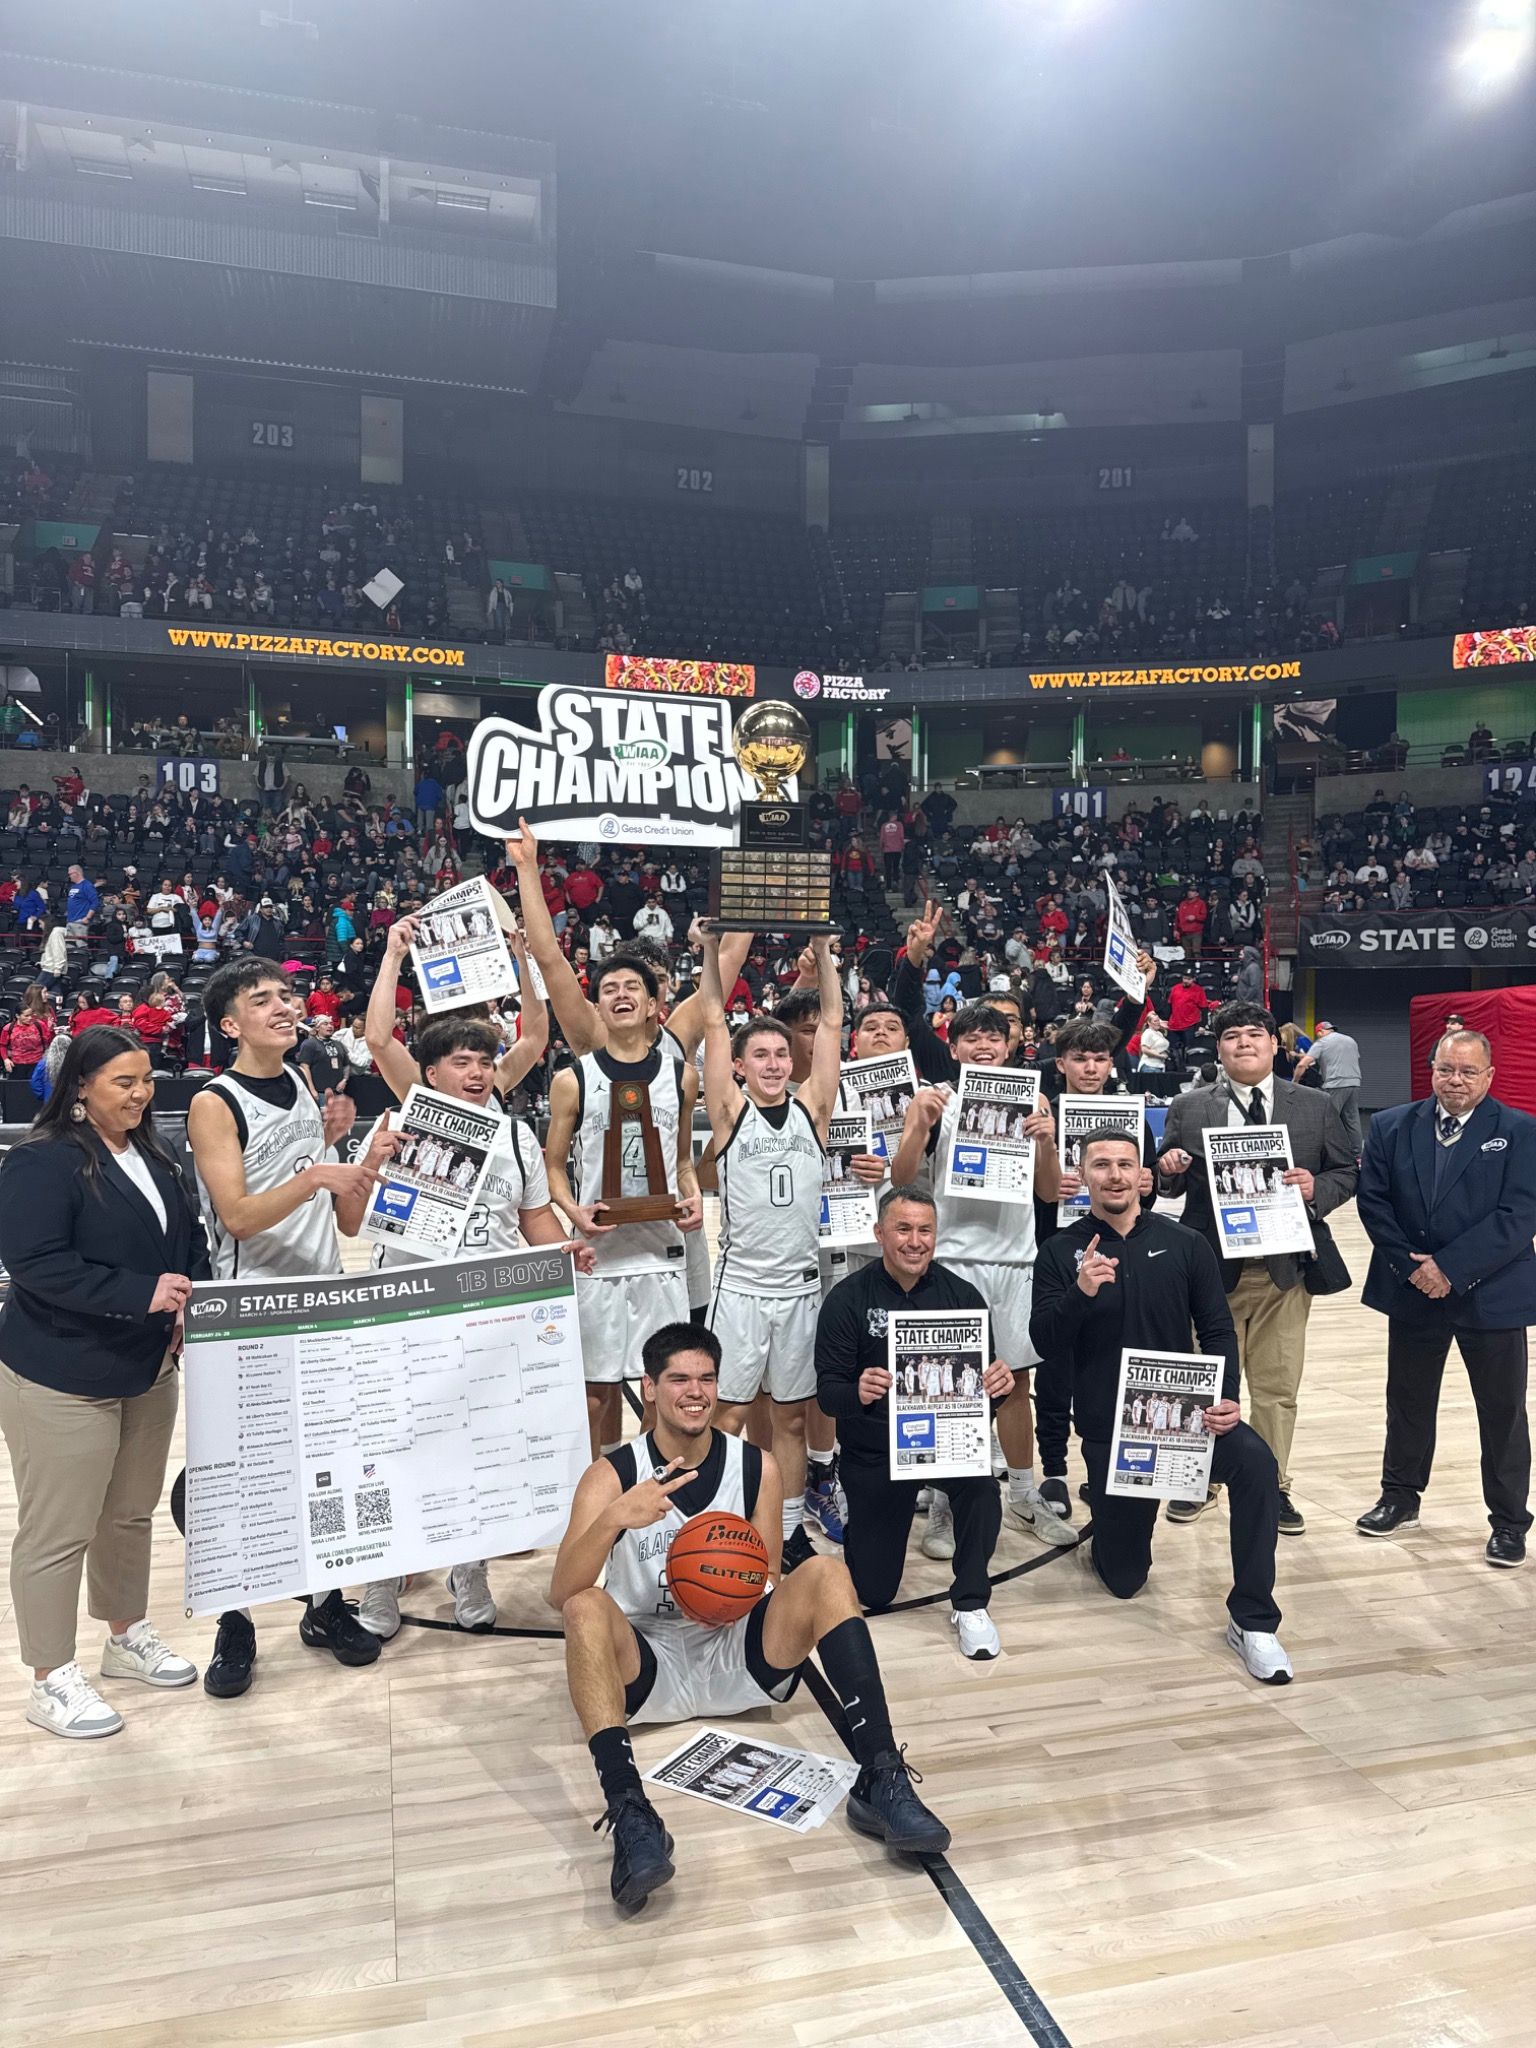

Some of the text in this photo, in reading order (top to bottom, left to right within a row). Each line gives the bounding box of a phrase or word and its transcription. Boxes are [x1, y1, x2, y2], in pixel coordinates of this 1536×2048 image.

[252, 421, 294, 448] 203
[677, 467, 713, 492] 202
[1099, 468, 1133, 489] 201
[168, 628, 465, 666] WWW.PIZZAFACTORY.COM
[822, 674, 864, 688] PIZZA
[1029, 661, 1301, 690] WWW.PIZZAFACTORY.COM
[822, 687, 887, 700] FACTORY
[555, 693, 719, 758] STATE
[621, 745, 659, 759] WIAA
[161, 760, 217, 794] 103
[476, 734, 788, 815] CHAMPION
[1060, 791, 1102, 818] 101
[621, 823, 694, 837] Gesa Credit Union
[1314, 935, 1345, 945] WIAA
[1359, 927, 1456, 952] STATE
[1490, 927, 1512, 936] Gesa
[1490, 934, 1518, 942] Credit
[1490, 941, 1515, 949] Union
[869, 1065, 910, 1083] CHAMPS!
[964, 1079, 1035, 1097] STATE CHAMPS!
[407, 1102, 496, 1143] STATE CHAMPS!
[826, 1125, 867, 1140] HAMPS!
[1065, 1116, 1138, 1130] STATE CHAMPS!
[622, 1135, 648, 1178] 4
[1210, 1139, 1286, 1154] STATE CHAMPS!
[769, 1164, 794, 1207] 0
[239, 1258, 564, 1313] STATE BASKETBALL 1B BOYS
[194, 1302, 222, 1316] WIAA
[895, 1328, 982, 1345] STATE CHAMPS!
[1127, 1366, 1162, 1382] STATE
[1163, 1369, 1217, 1387] CHAMPS!
[188, 1460, 236, 1474] OPENING ROUND
[705, 1524, 764, 1551] Baden
[699, 1563, 765, 1584] ELITE PRO
[662, 1735, 732, 1785] STATE CHAMPS!
